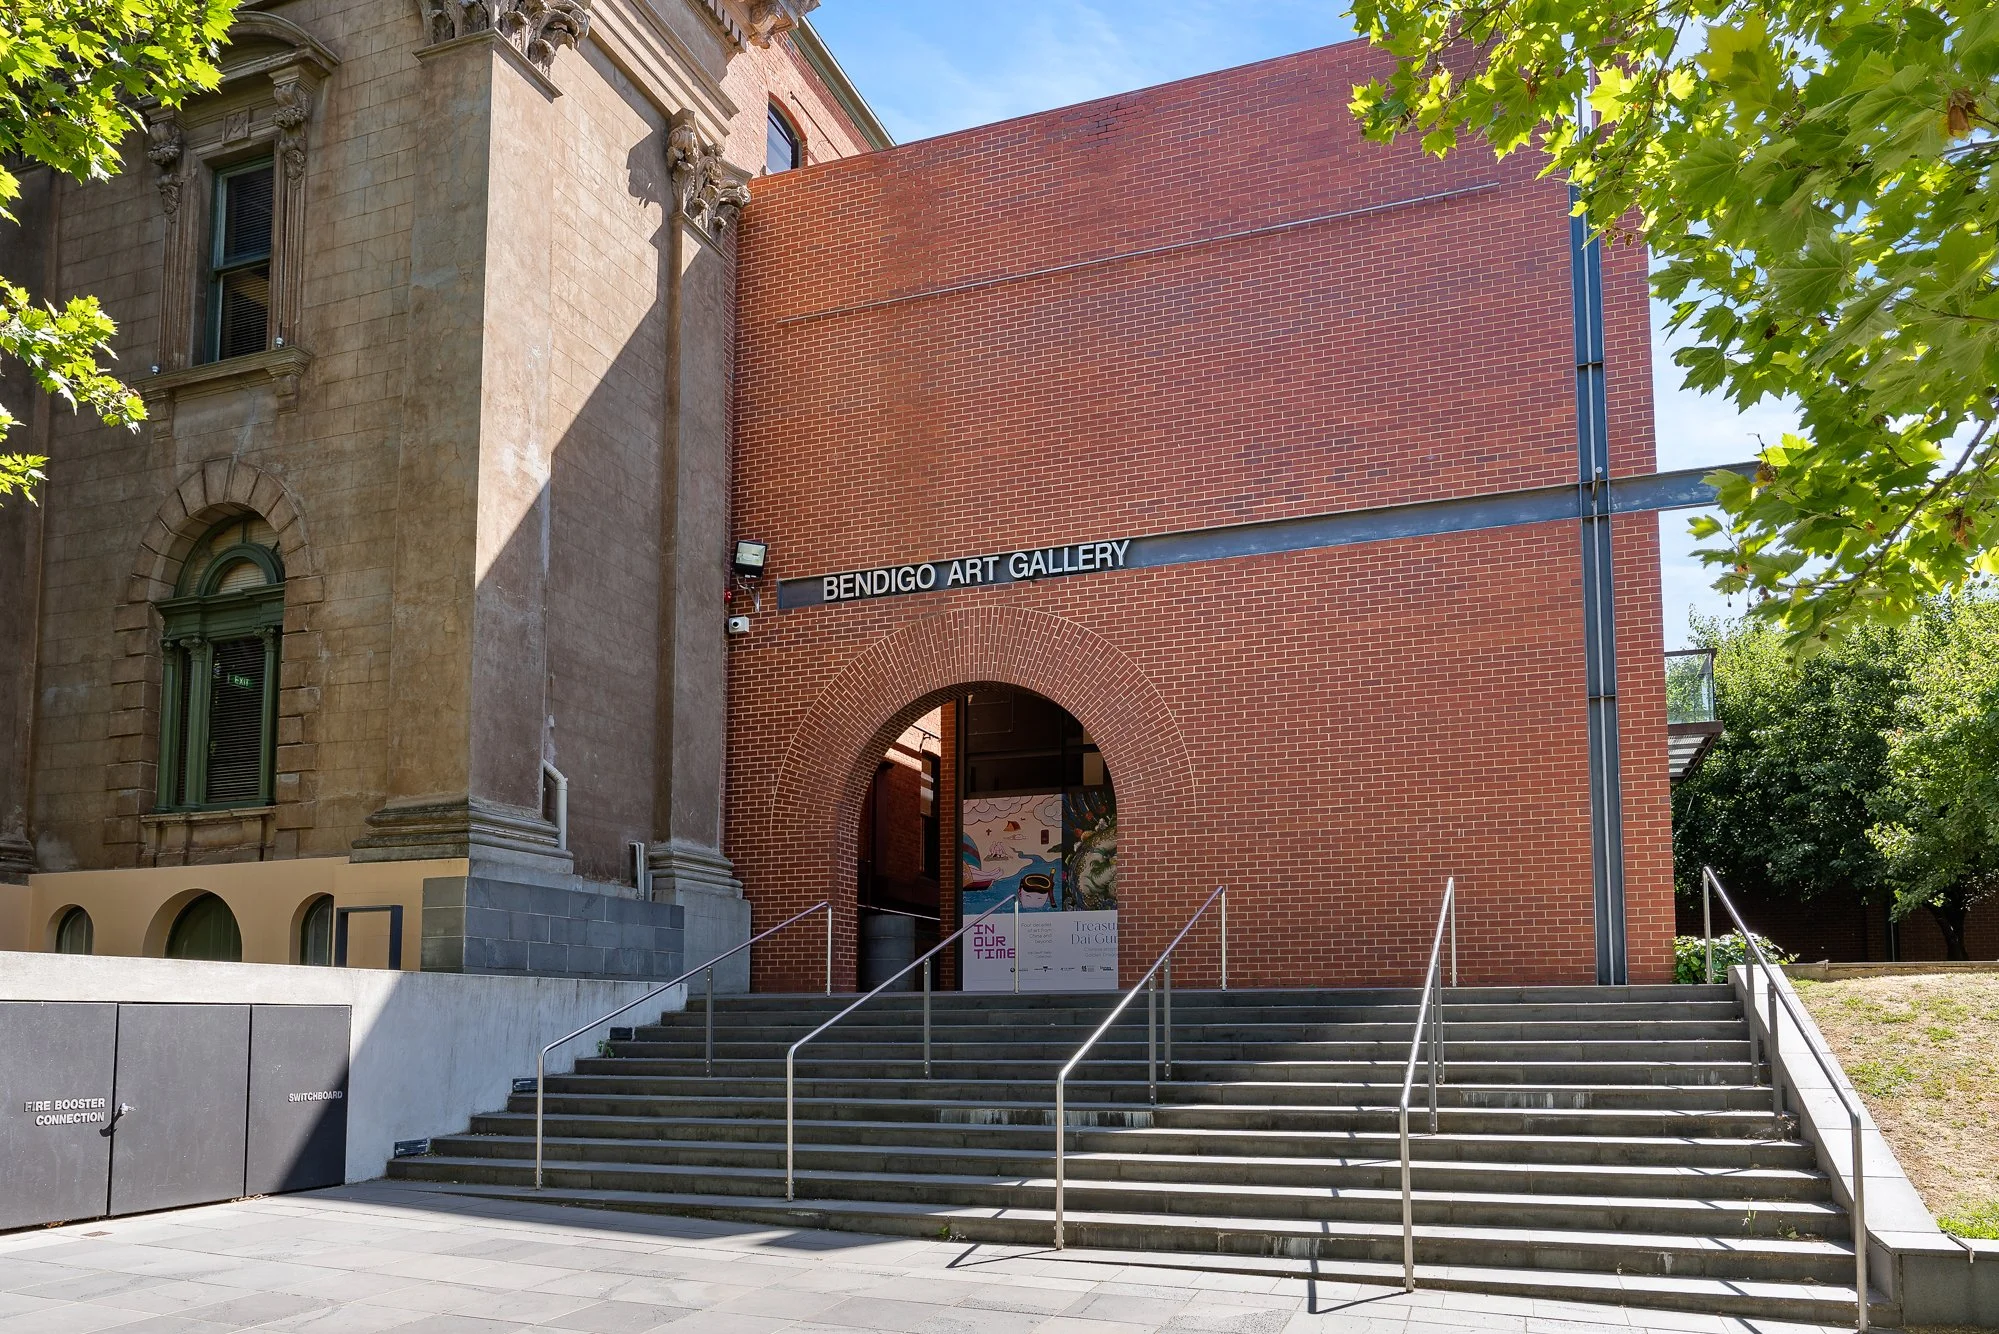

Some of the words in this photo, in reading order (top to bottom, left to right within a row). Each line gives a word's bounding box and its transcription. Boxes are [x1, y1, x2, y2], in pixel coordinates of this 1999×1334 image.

[823, 563, 936, 601] BENDIGO
[947, 555, 999, 586] ART
[1008, 540, 1130, 579] GALLERY
[234, 675, 249, 687] EXIT
[974, 924, 995, 935] IN
[974, 936, 1006, 947] OUR
[1071, 933, 1090, 945] Dai
[974, 948, 1016, 960] TIME
[288, 1090, 343, 1102] SWITCHBOARD
[24, 1100, 51, 1112] FIRE
[54, 1098, 105, 1111] BOOSTER
[35, 1111, 105, 1126] CONNECTION
